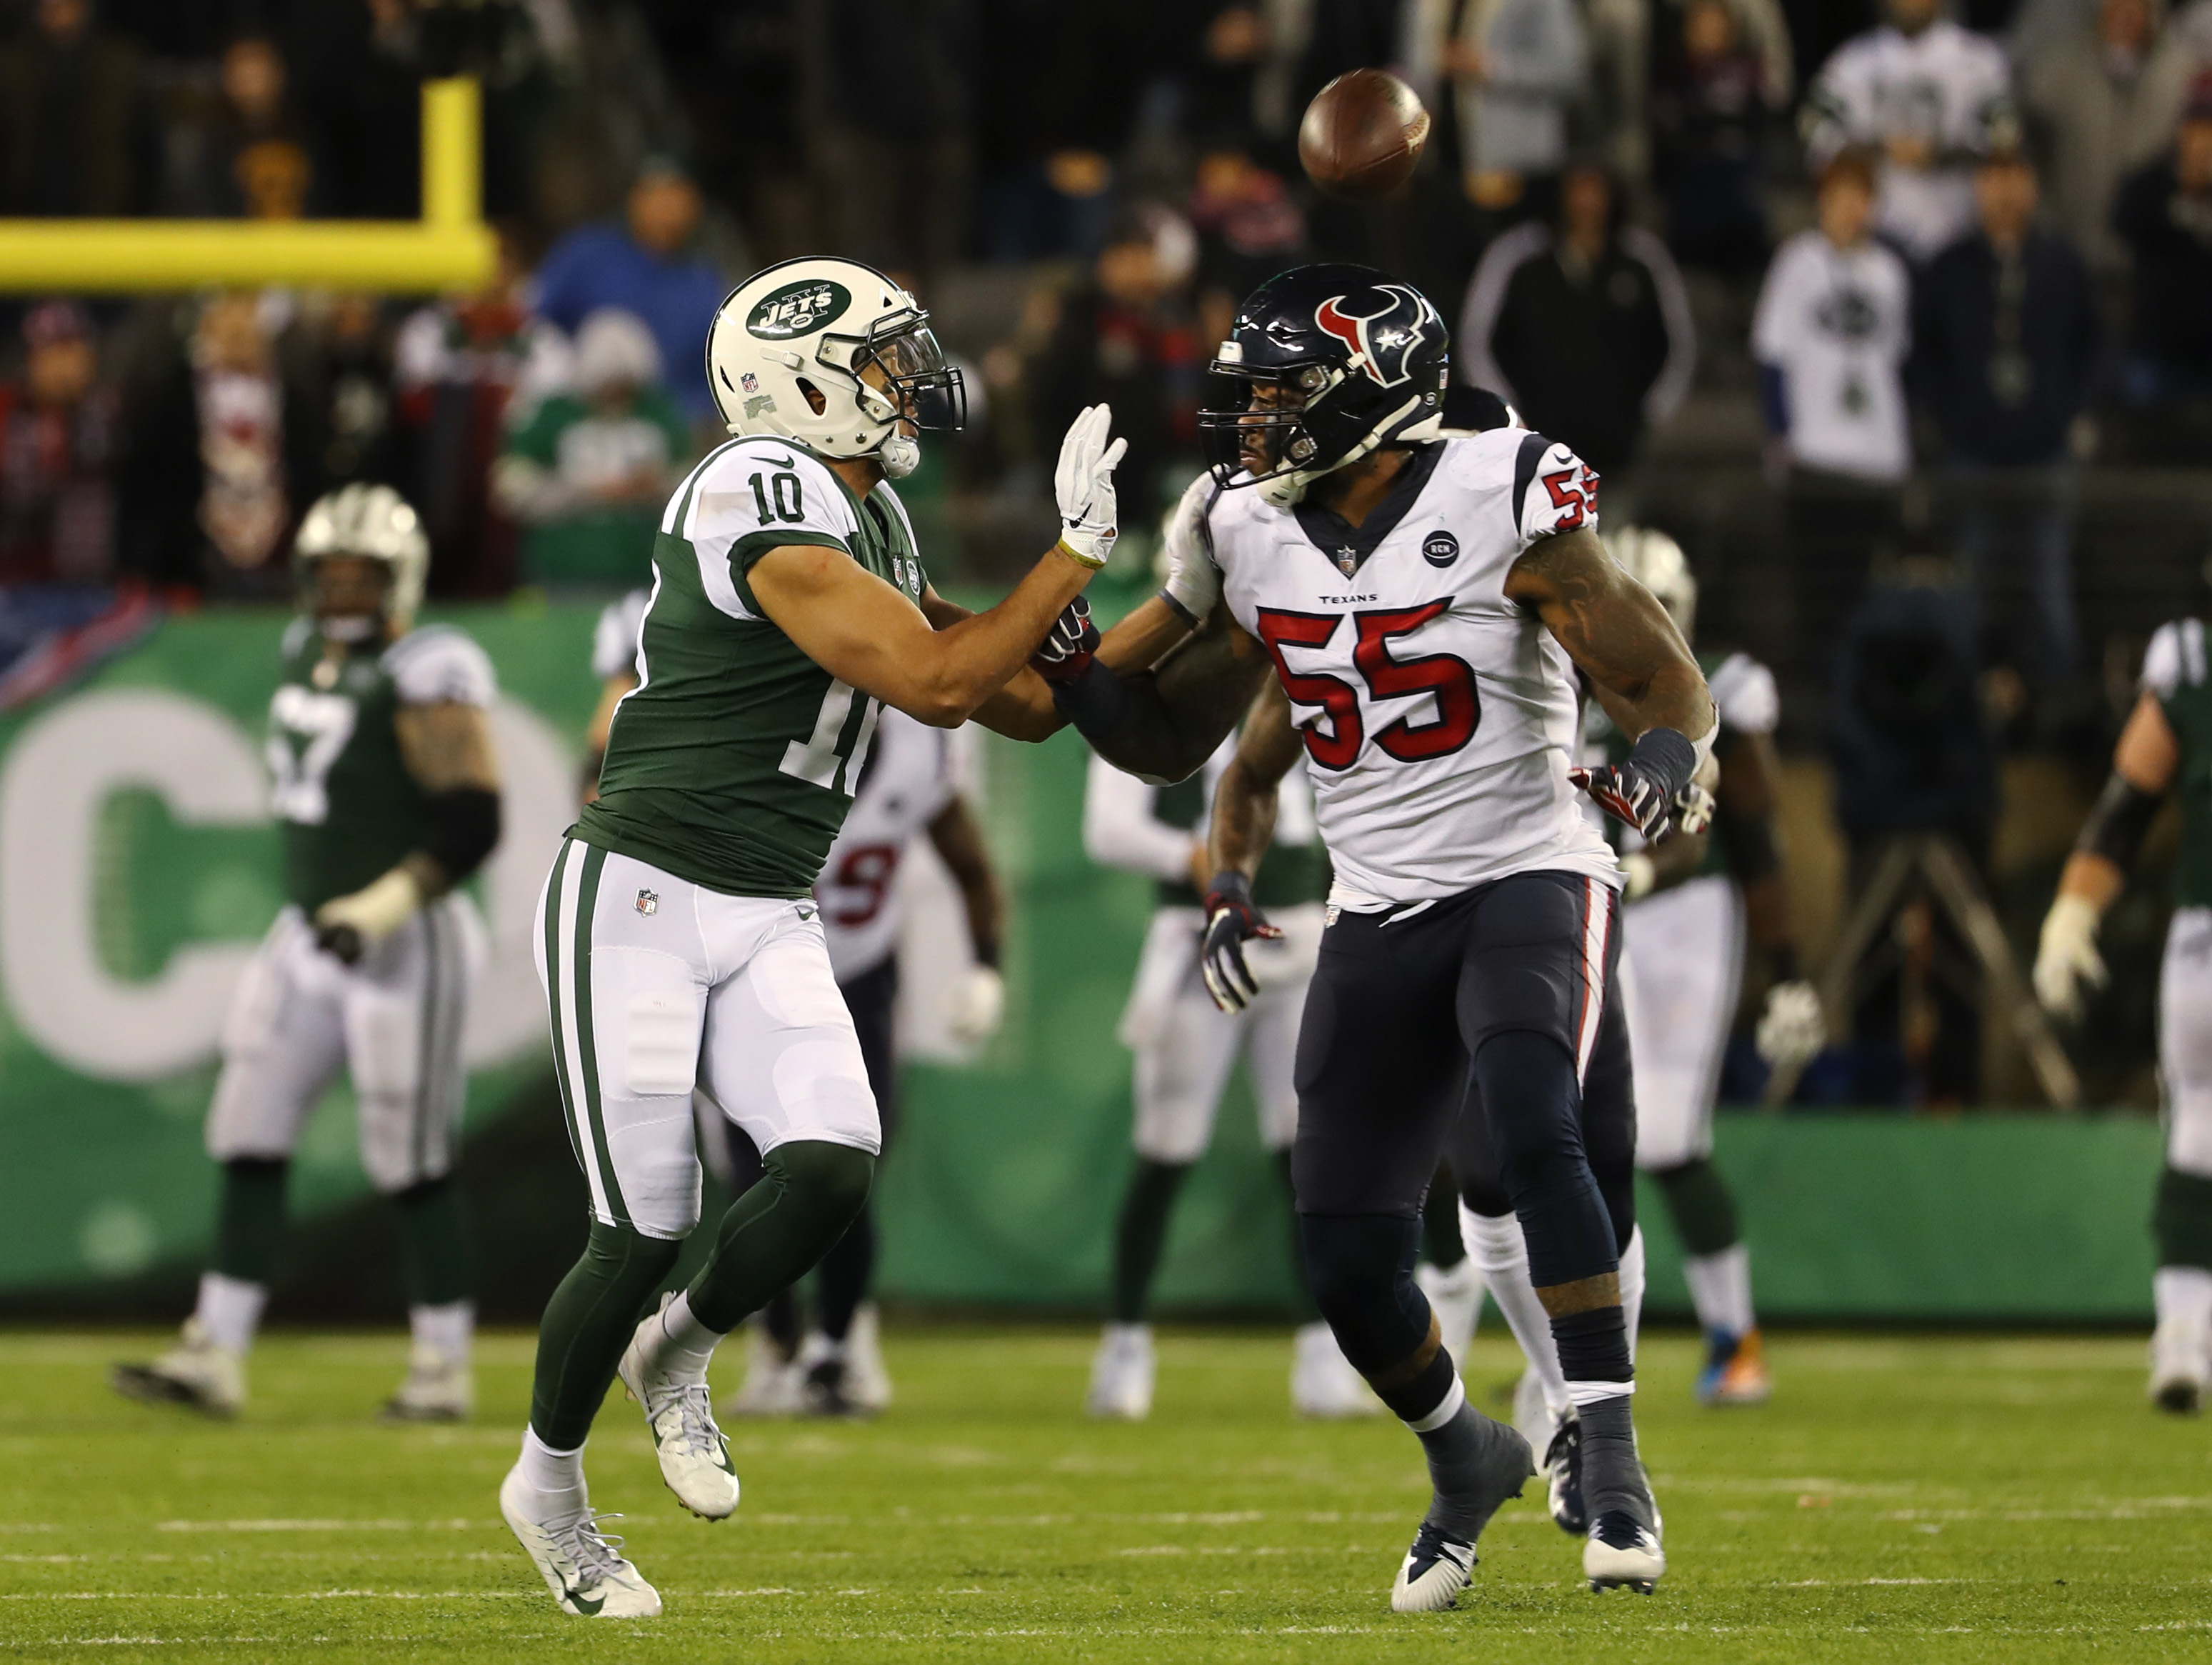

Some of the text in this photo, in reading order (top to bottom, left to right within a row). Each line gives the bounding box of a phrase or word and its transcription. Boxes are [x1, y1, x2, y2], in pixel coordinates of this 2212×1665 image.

[759, 292, 832, 327] JETS
[748, 472, 806, 526] 10
[1318, 594, 1378, 604] TEXANS
[1255, 596, 1481, 771] 55
